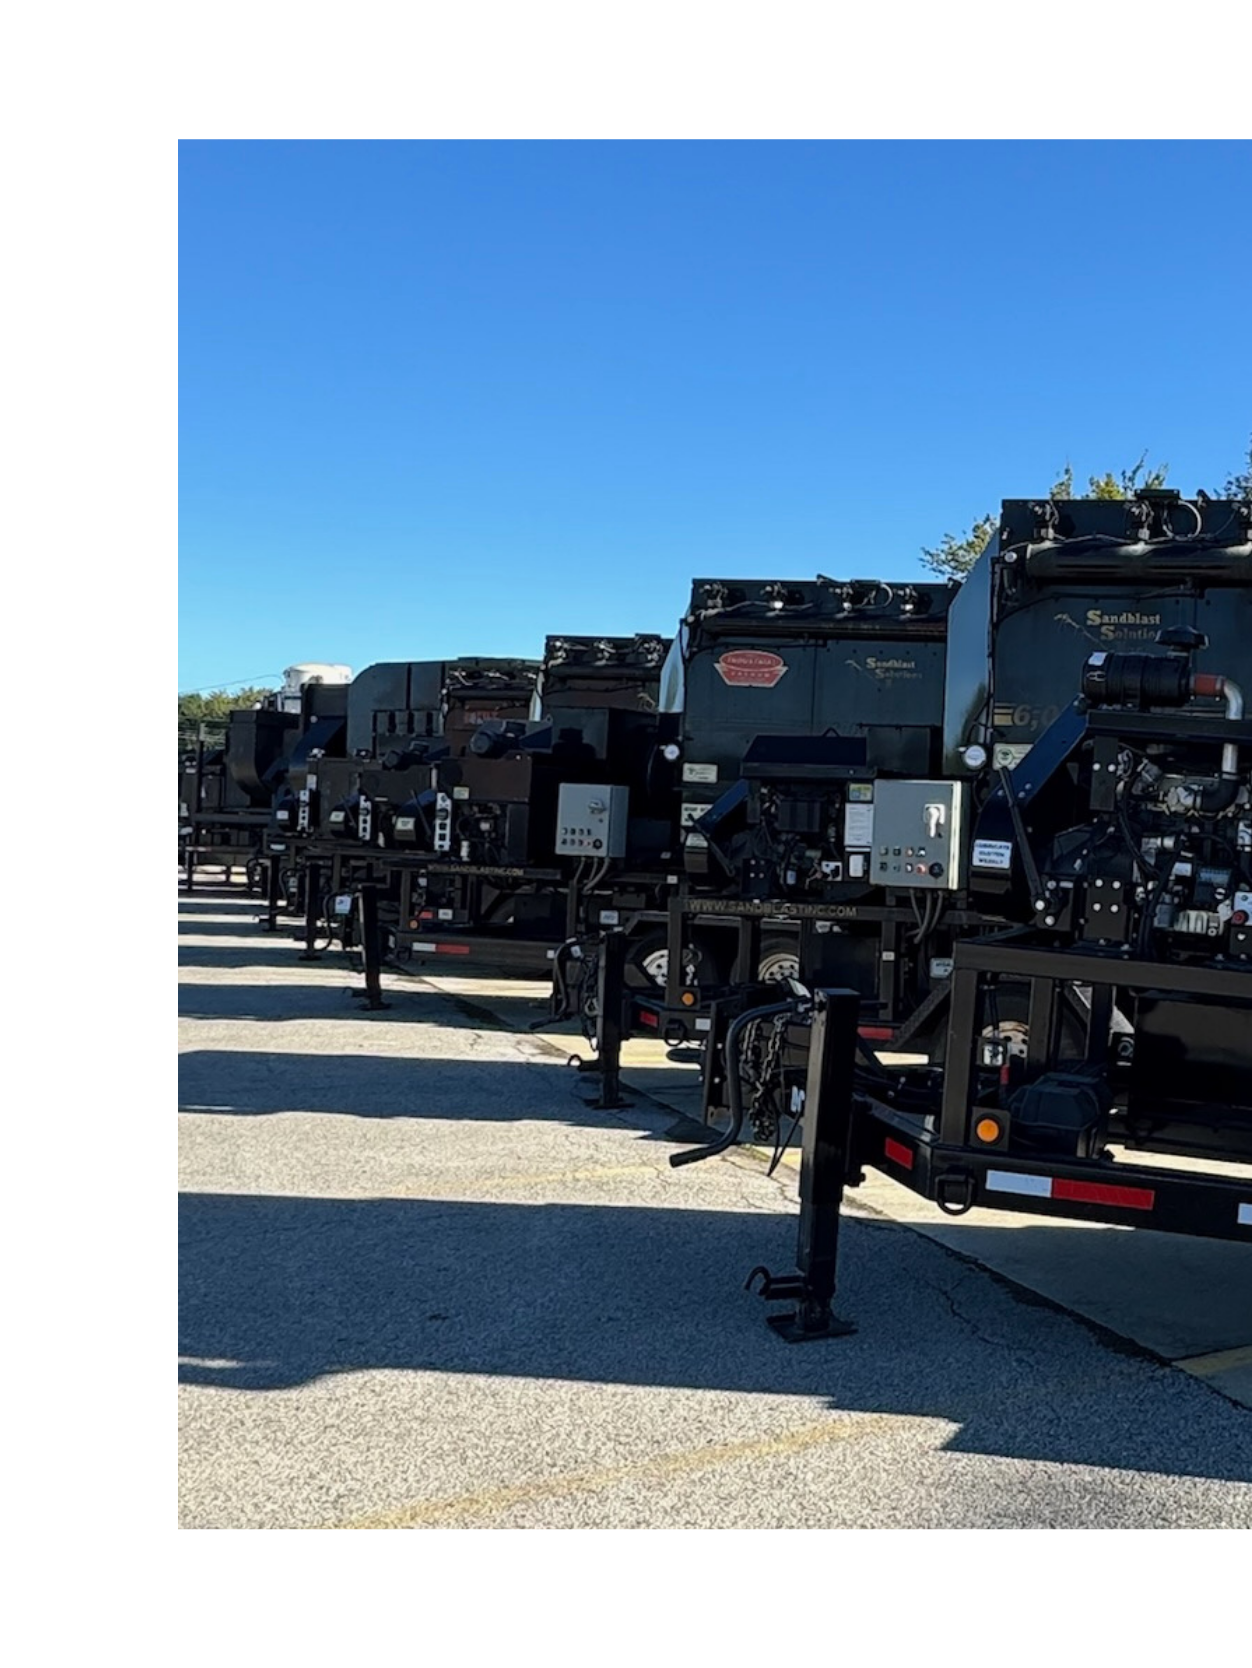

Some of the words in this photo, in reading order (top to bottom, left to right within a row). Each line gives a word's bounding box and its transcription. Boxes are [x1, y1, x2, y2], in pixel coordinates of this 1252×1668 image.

[1086, 609, 1161, 626] Sandblast
[1100, 625, 1156, 641] Solutio
[1013, 704, 1060, 732] 6,0
[689, 900, 857, 917] WWW.SANDBLASTINC.COM
